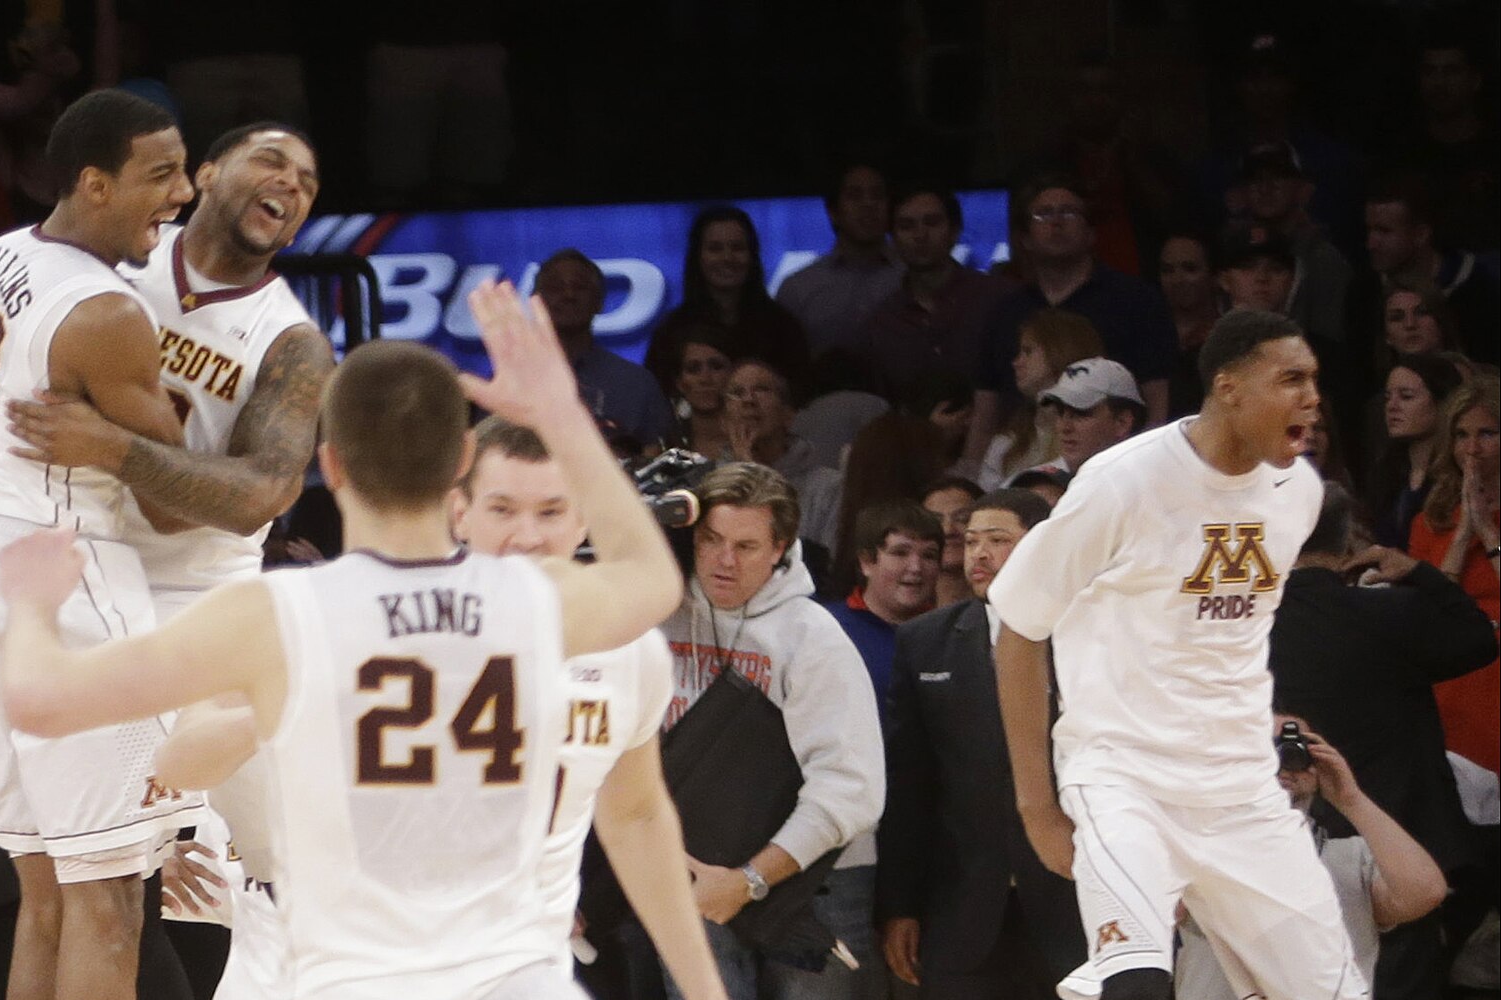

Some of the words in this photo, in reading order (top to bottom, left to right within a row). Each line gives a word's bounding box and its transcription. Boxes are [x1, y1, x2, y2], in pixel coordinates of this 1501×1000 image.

[1180, 522, 1281, 594] M
[377, 588, 483, 639] KING
[1196, 593, 1258, 620] PRIDE
[355, 651, 527, 789] 24
